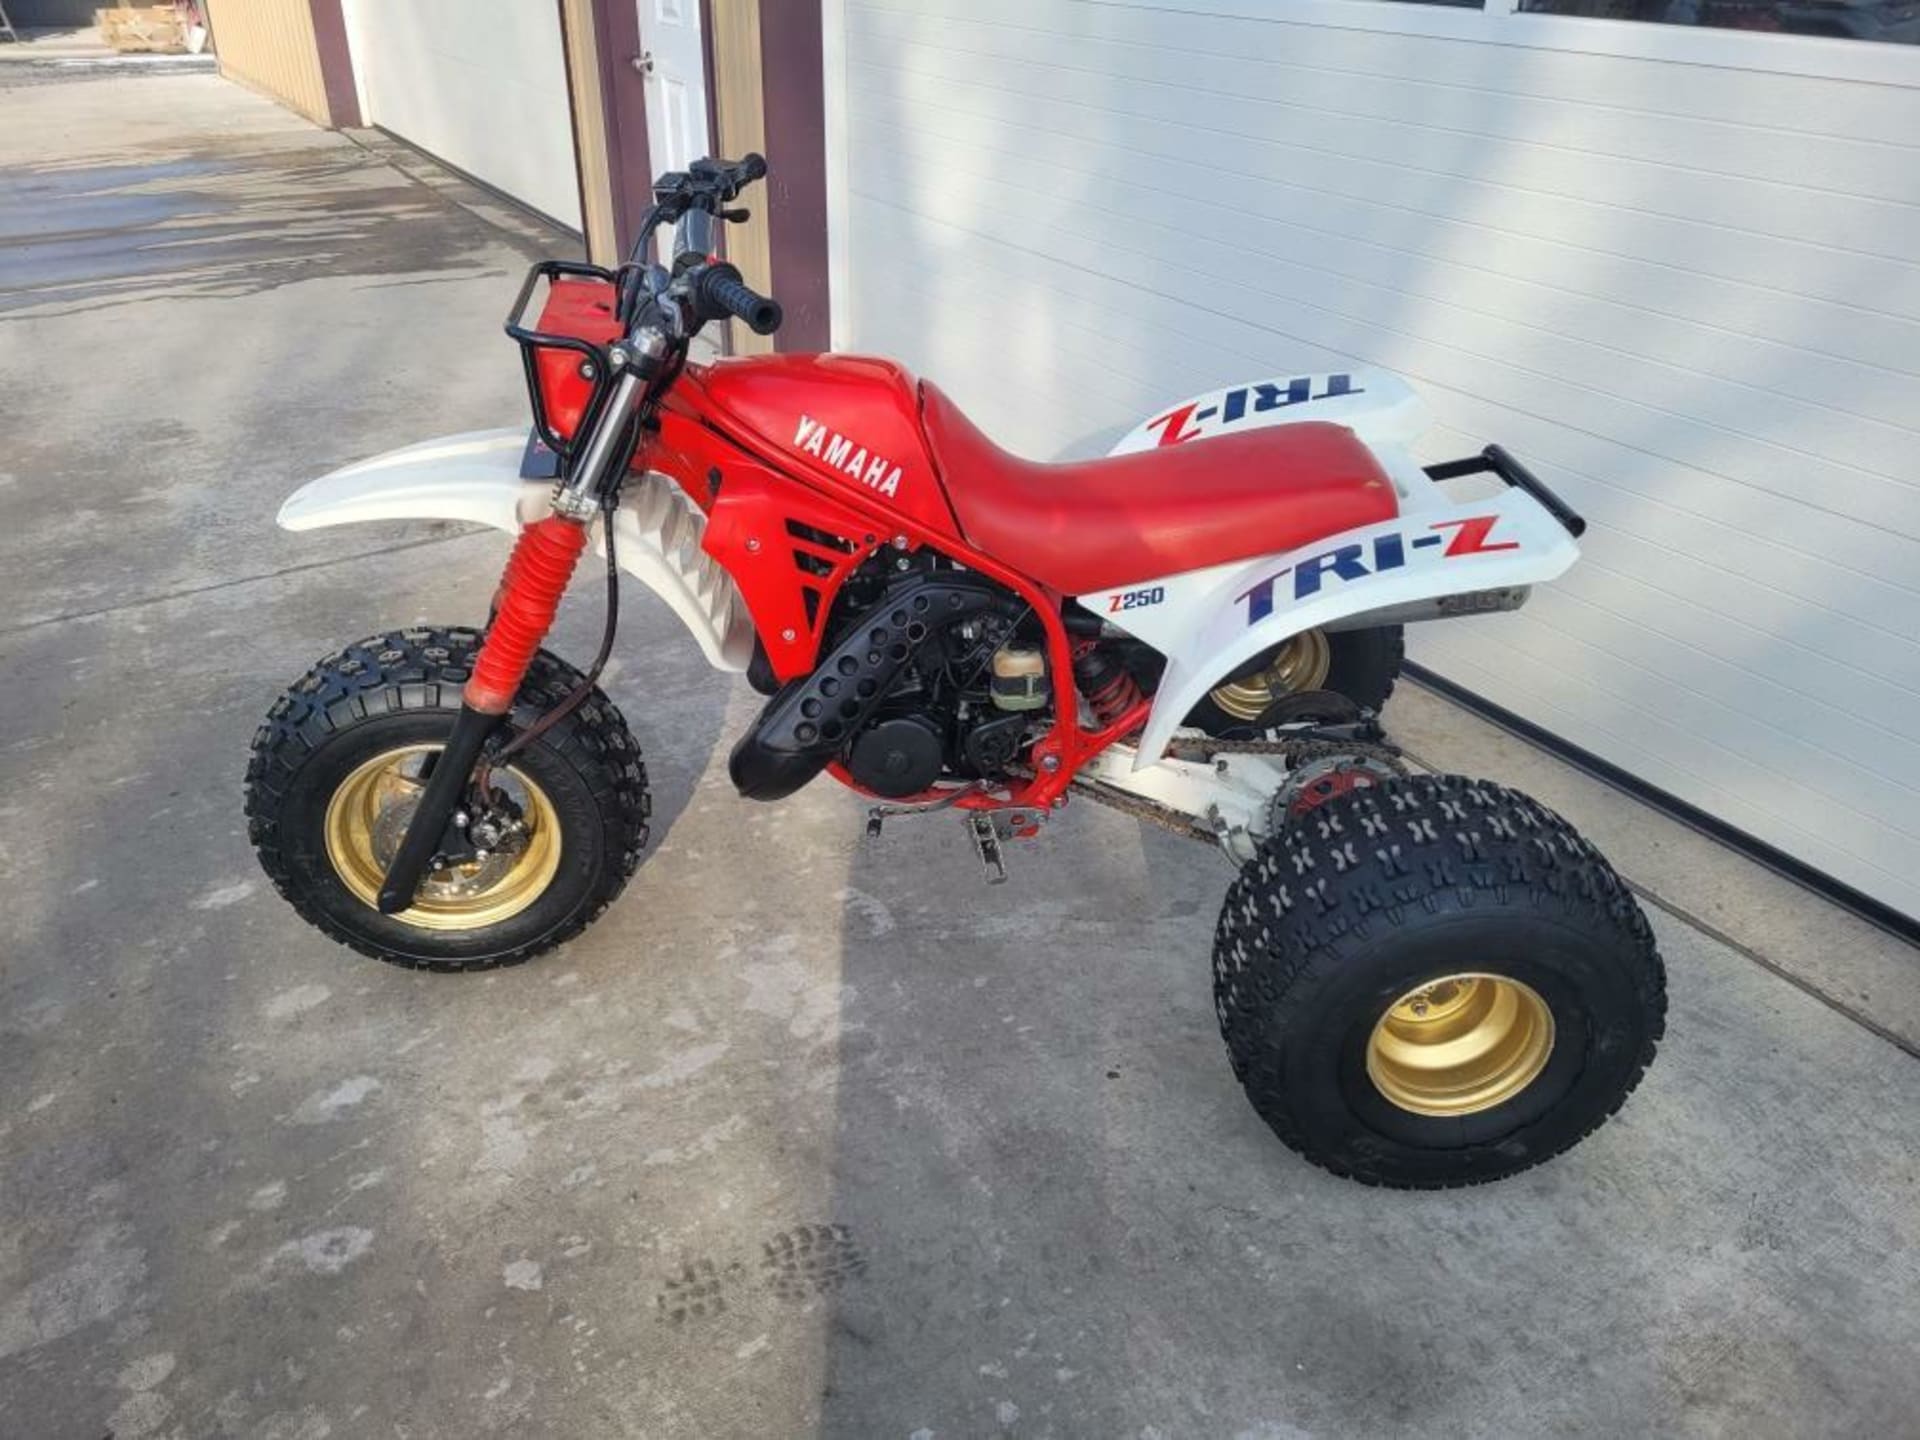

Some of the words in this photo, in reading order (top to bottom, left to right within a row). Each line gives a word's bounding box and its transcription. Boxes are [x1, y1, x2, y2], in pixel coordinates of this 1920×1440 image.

[1146, 373, 1365, 447] TRI-Z
[793, 414, 902, 498] YAMAHA
[1109, 586, 1164, 612] Z250
[1234, 515, 1520, 626] TRI-Z
